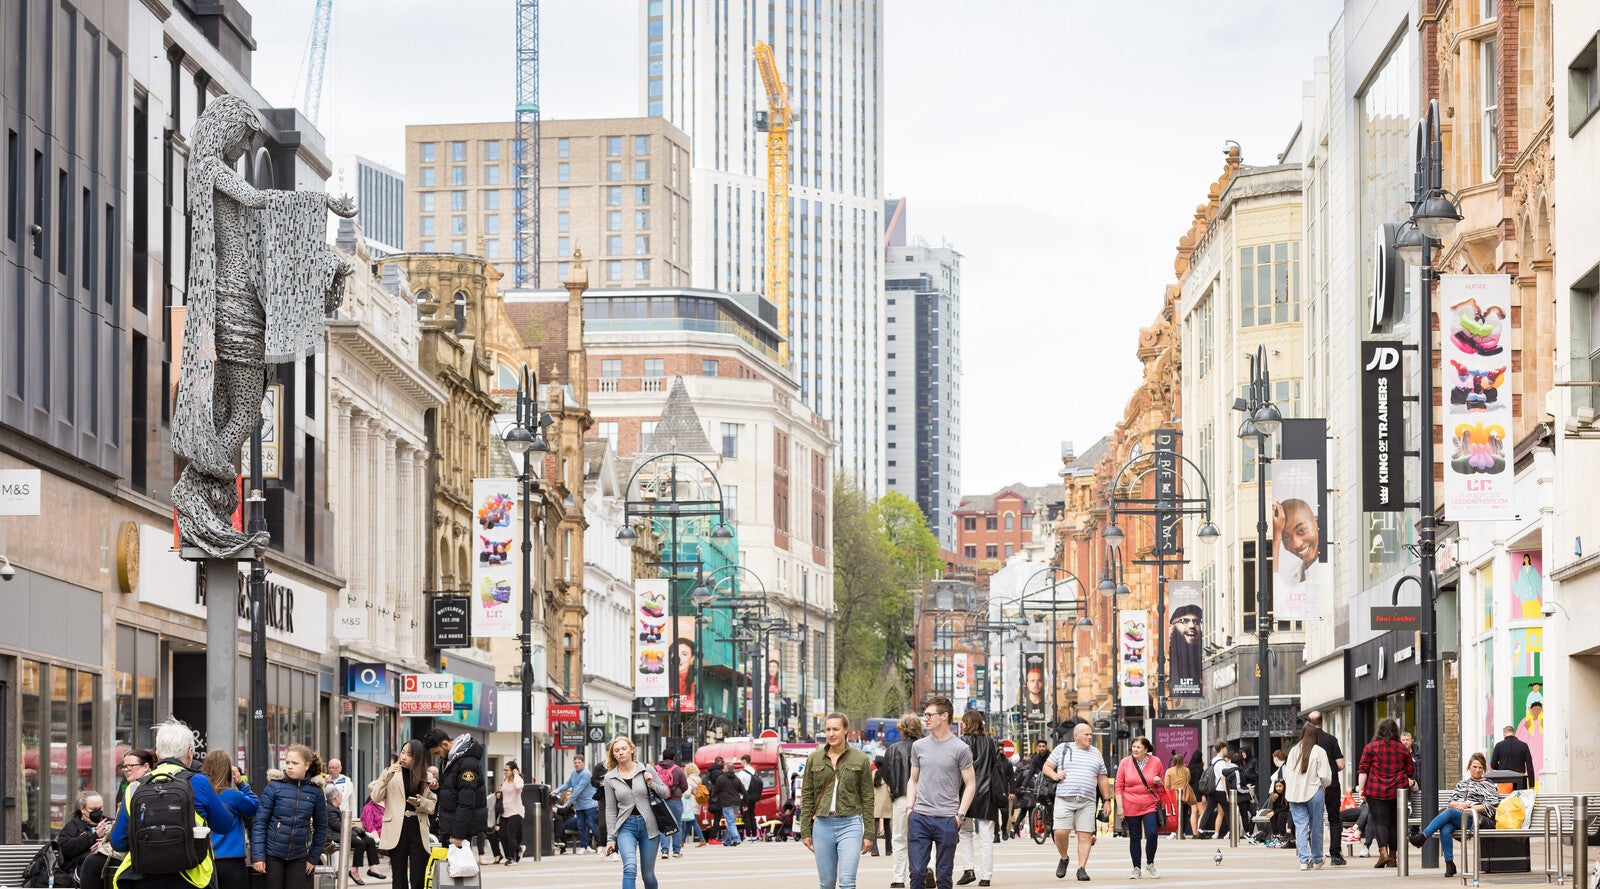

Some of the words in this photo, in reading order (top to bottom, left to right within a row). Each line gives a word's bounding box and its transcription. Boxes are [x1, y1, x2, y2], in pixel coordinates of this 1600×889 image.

[1365, 347, 1400, 371] JD
[1378, 377, 1389, 439] TRAINERS
[1379, 439, 1389, 453] OF
[1379, 453, 1389, 484] KING
[2, 484, 30, 496] M&S
[341, 618, 361, 626] M&S
[360, 668, 380, 688] O2
[421, 681, 432, 689] TO
[434, 681, 449, 689] LET
[402, 702, 417, 710] 0113
[433, 702, 451, 710] 4848
